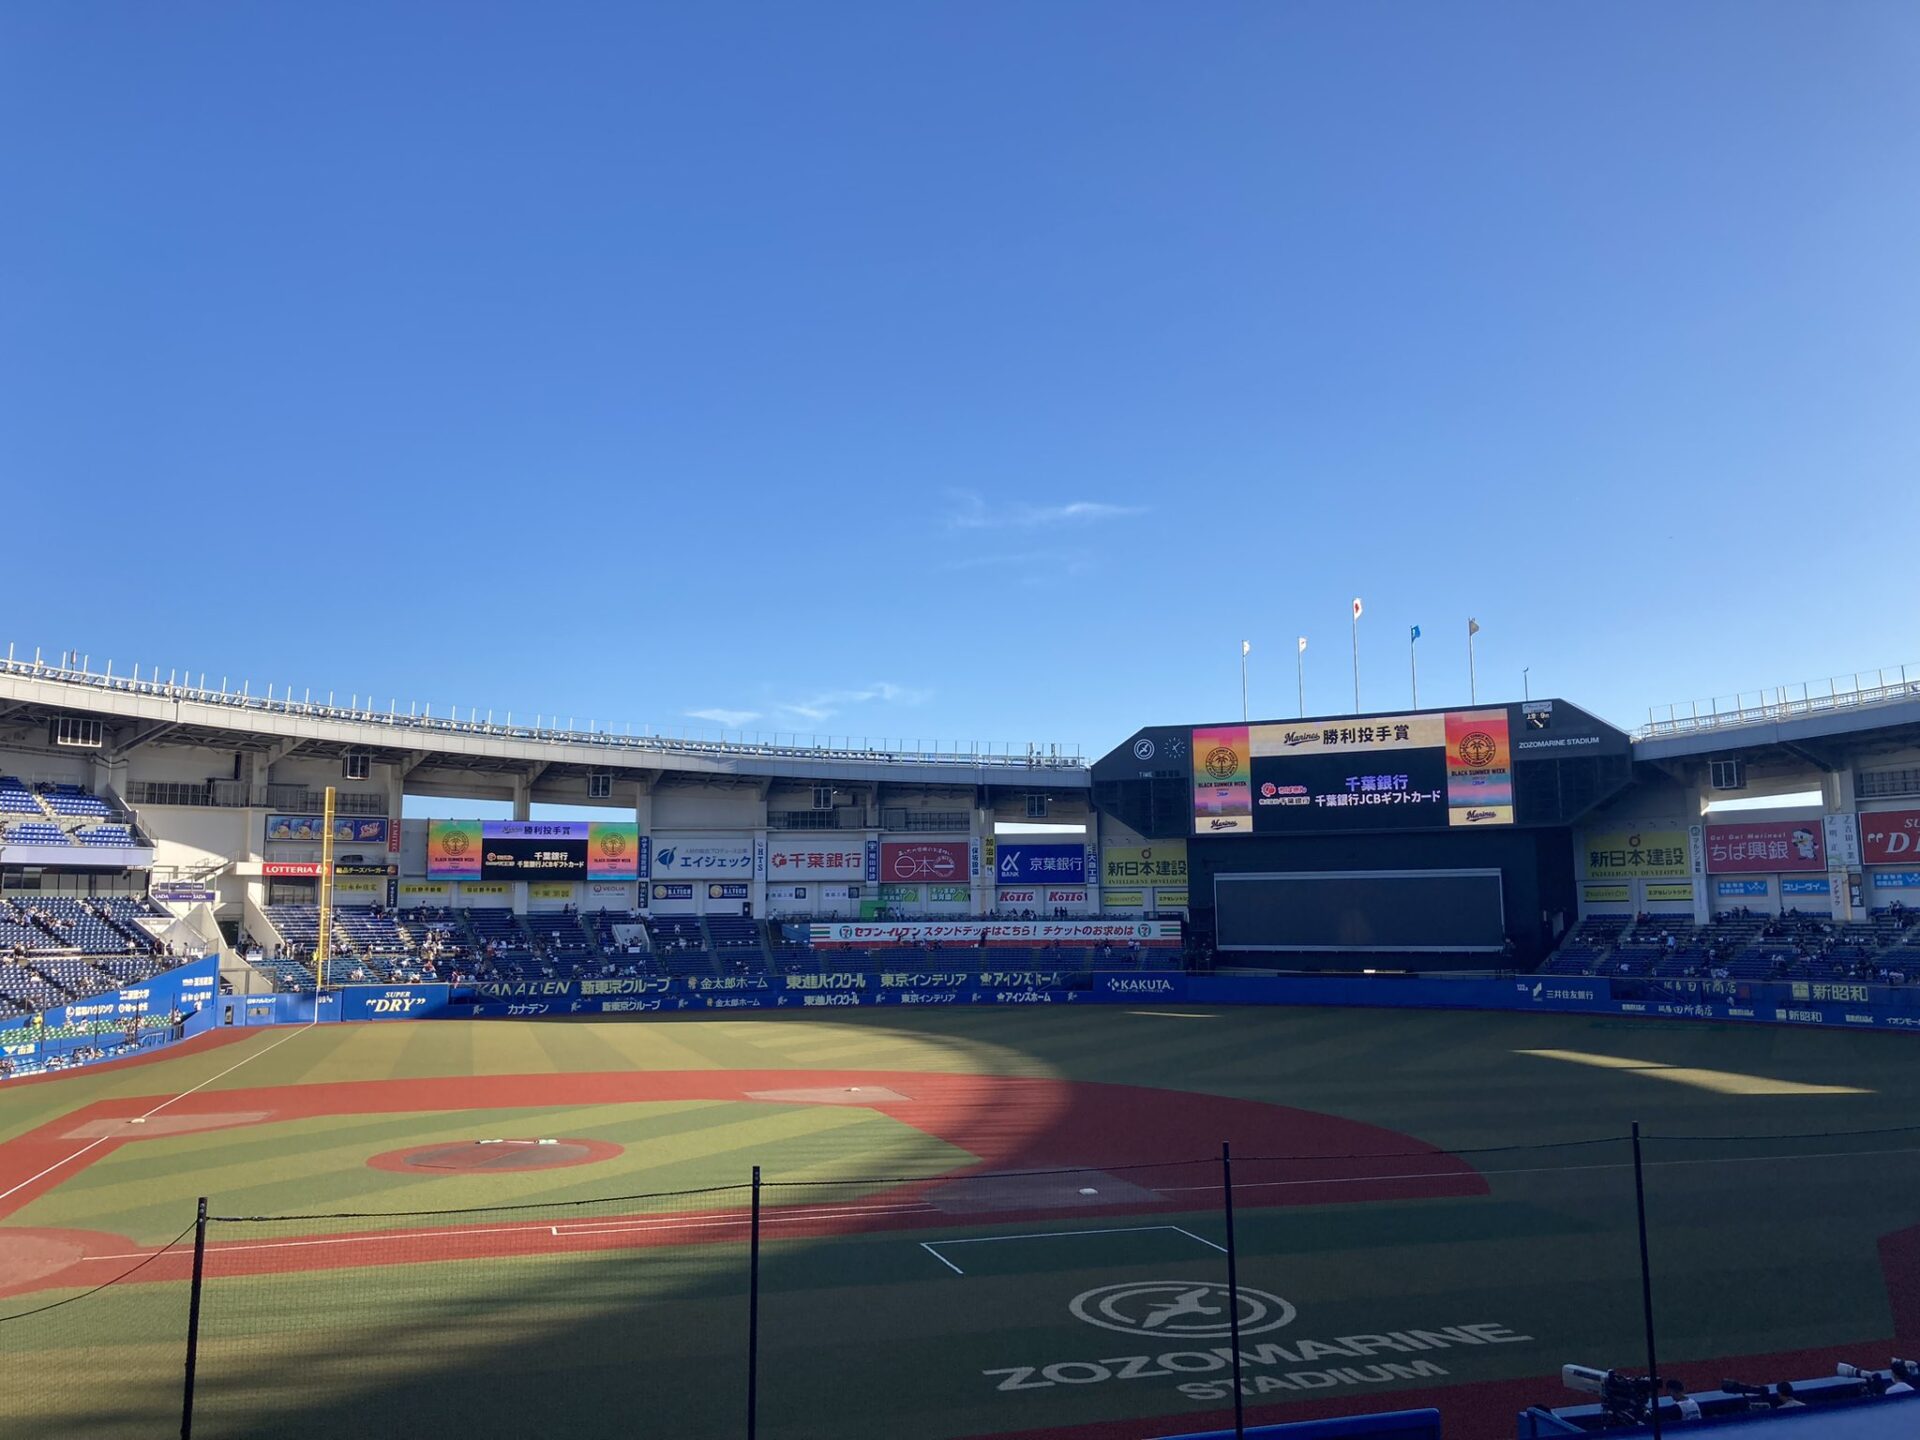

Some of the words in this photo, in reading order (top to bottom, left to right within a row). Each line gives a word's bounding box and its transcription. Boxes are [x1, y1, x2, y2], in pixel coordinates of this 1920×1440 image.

[1283, 731, 1320, 746] Marines
[1323, 724, 1409, 745] 勝利投手賞
[1518, 739, 1566, 749] ZOZOMARINE
[1566, 736, 1600, 746] STADIUM
[1345, 773, 1408, 792] 千葉銀行
[1315, 790, 1441, 807] 千葉銀行JCBギフトカード
[1466, 809, 1496, 822] Marines
[523, 825, 571, 836] 勝利投手賞
[534, 851, 568, 861] 千葉銀行
[1710, 840, 1790, 861] ちば興銀
[681, 856, 751, 867] エイジェック
[788, 853, 862, 868] 千葉銀行
[1029, 857, 1082, 871] 京葉銀行
[1590, 847, 1685, 868] 新日本建設
[265, 865, 313, 873] LOTTERIA
[1107, 860, 1187, 876] 新日本建設
[1043, 925, 1134, 936] チケットのお求めは
[580, 977, 671, 994] 新東京グループ
[700, 976, 768, 990] 金太郎ホーム
[786, 973, 866, 989] 東進ハイスクール
[880, 973, 967, 987] 東京インテリア
[1121, 978, 1170, 989] KAKUTA
[901, 994, 956, 1003] 東京インテリア
[1005, 992, 1051, 1002] アインズホーム
[1546, 990, 1593, 1000] 三井住友銀行
[1812, 984, 1868, 1001] 新昭和
[602, 1000, 661, 1012] 新東京グループ
[715, 998, 760, 1008] 金太郎ホーム
[803, 994, 859, 1006] 東進ハイスクール
[507, 1003, 549, 1015] カナデン
[1789, 1010, 1822, 1022] 新昭和
[982, 1323, 1534, 1391] ZOZOMARINE
[1176, 1360, 1450, 1399] STADIUM
